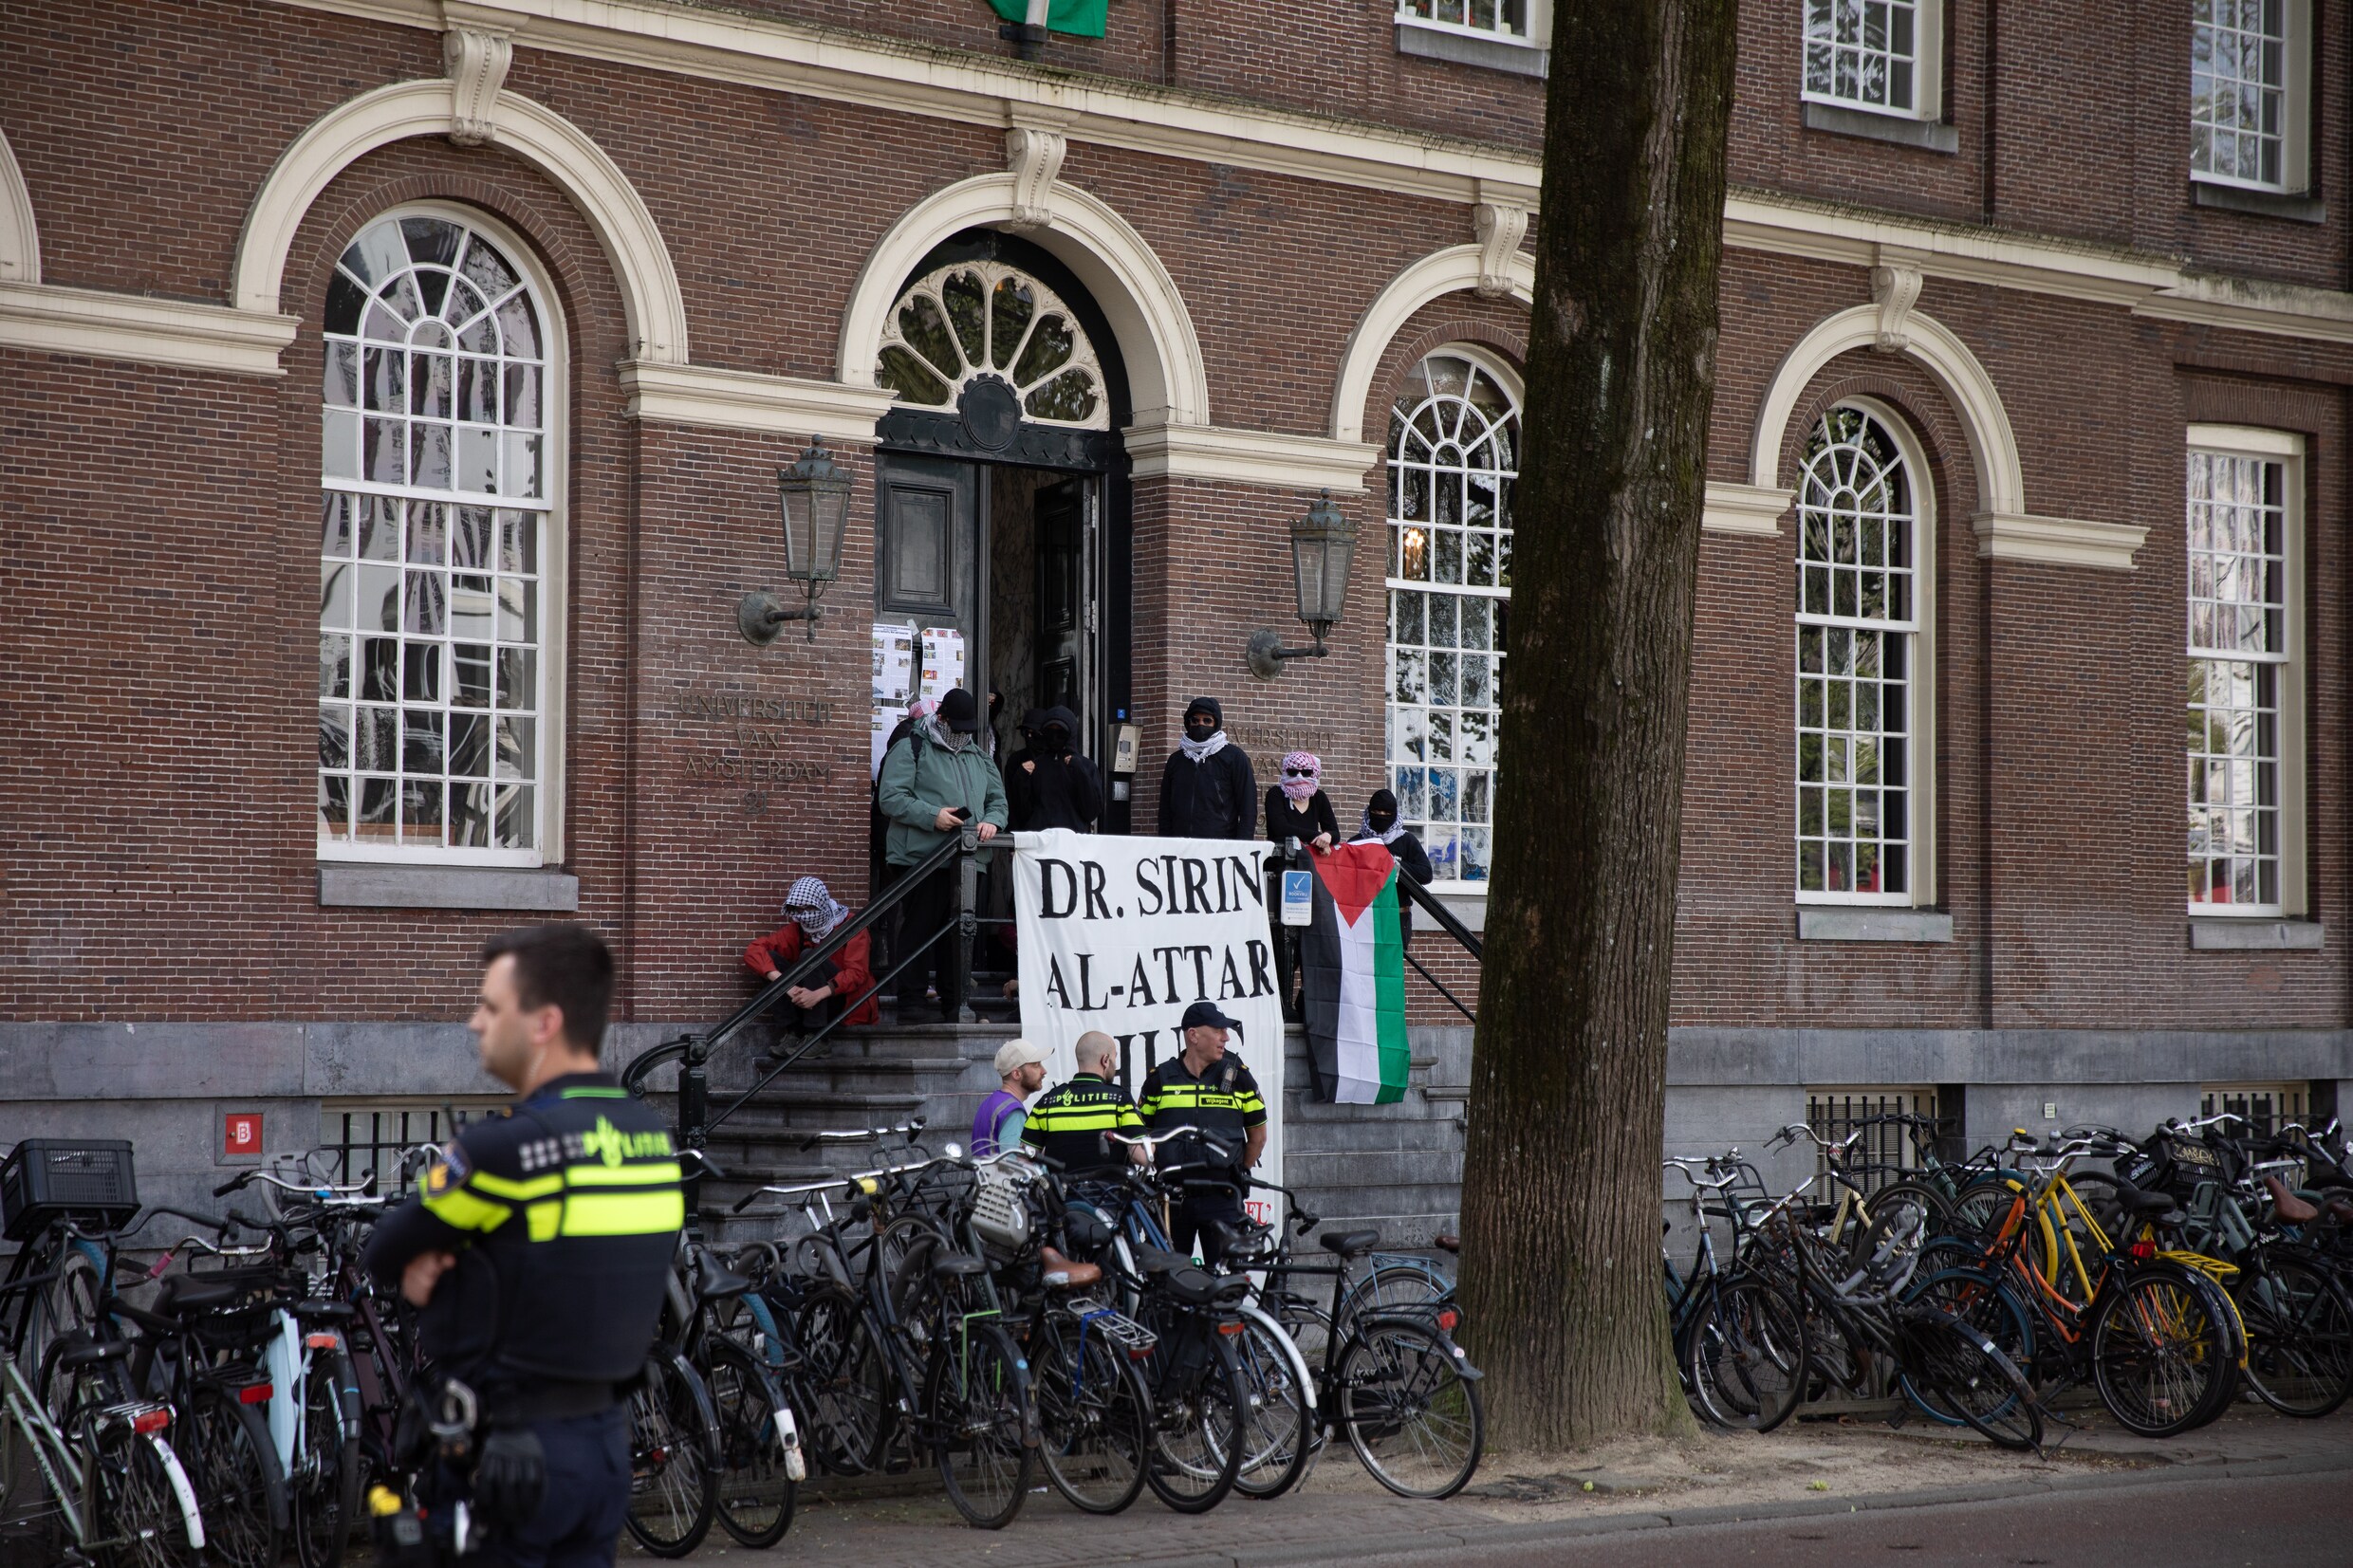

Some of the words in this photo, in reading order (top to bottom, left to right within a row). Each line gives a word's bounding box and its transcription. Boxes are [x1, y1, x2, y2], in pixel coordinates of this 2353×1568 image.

[678, 693, 835, 722] UNIVERSITEIT
[735, 729, 780, 749] VAN
[1224, 724, 1335, 750] IVERSITEIT
[683, 757, 832, 784] AMSTERDAM
[744, 789, 768, 814] 21
[1035, 858, 1124, 919] DR.
[1136, 850, 1263, 917] SIRIN
[1047, 939, 1275, 1011] AL-ATTAR
[1056, 1091, 1109, 1105] POLITIE
[238, 1124, 250, 1141] B
